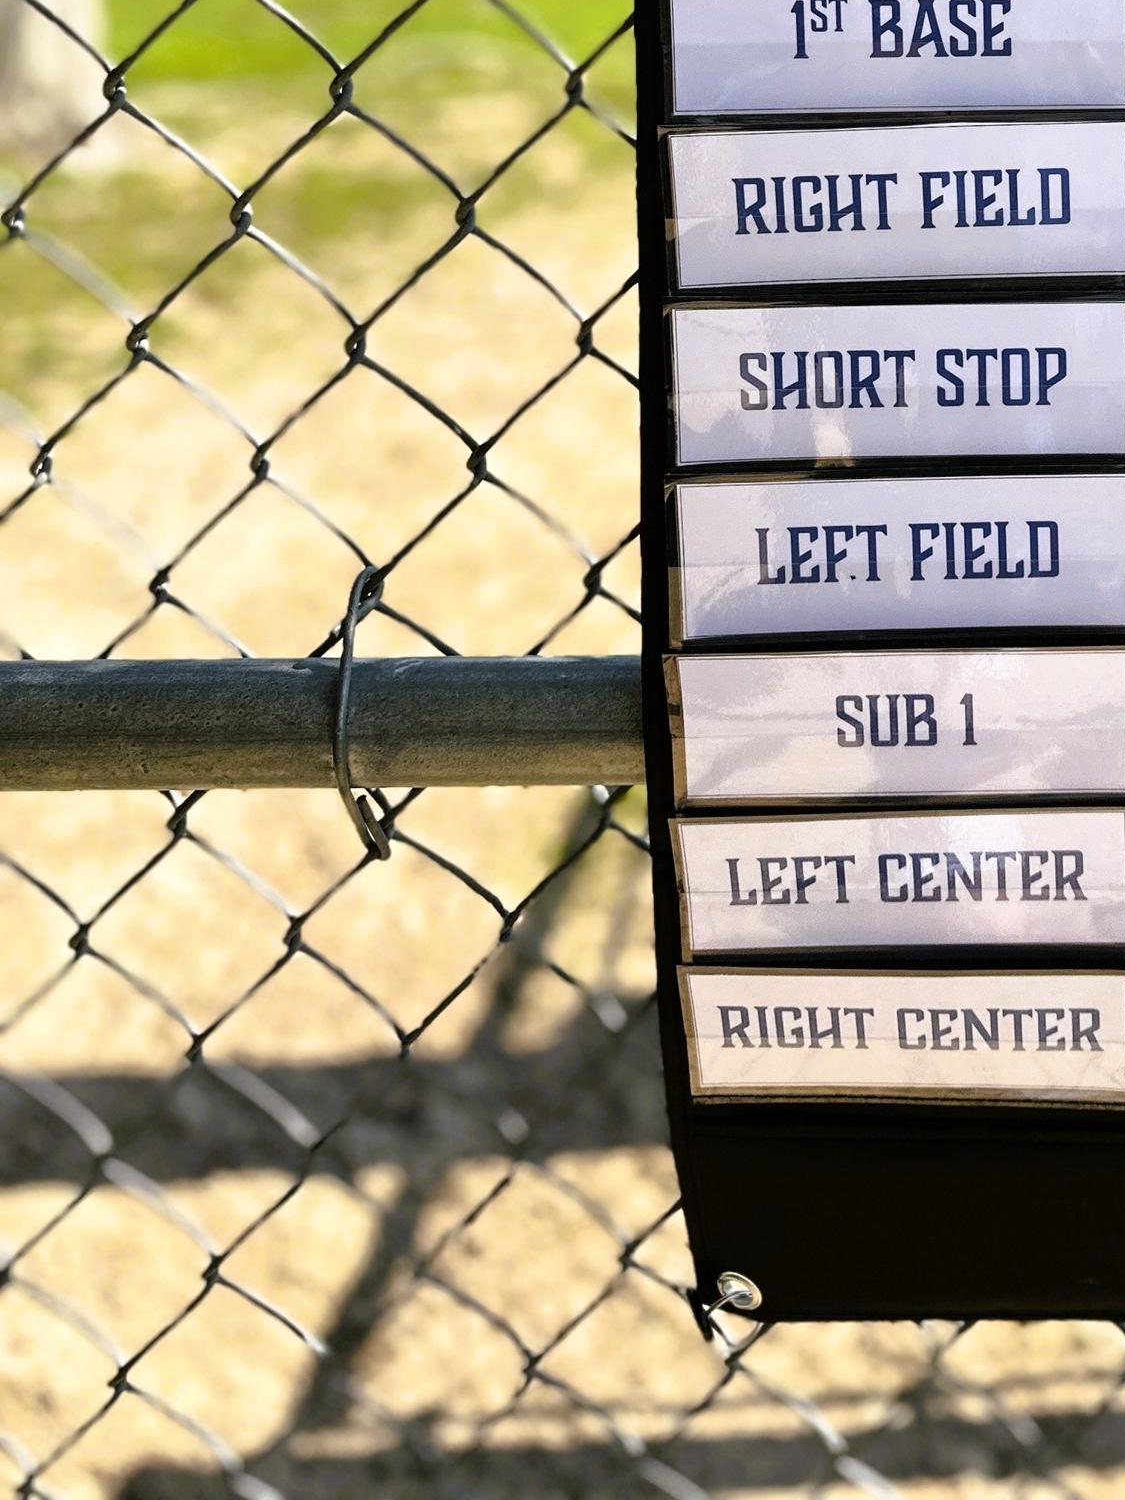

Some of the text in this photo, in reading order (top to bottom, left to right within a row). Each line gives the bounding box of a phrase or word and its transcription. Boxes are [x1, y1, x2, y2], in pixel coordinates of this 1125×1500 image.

[731, 167, 1069, 235] RIGHT FIELD
[740, 348, 1066, 410] SHORT STOP
[755, 520, 1060, 585] LEFT FIELD
[835, 692, 977, 747] SUB 1
[726, 850, 1088, 905] LEFT CENTER
[716, 1005, 1105, 1051] RIGHT CENTER
